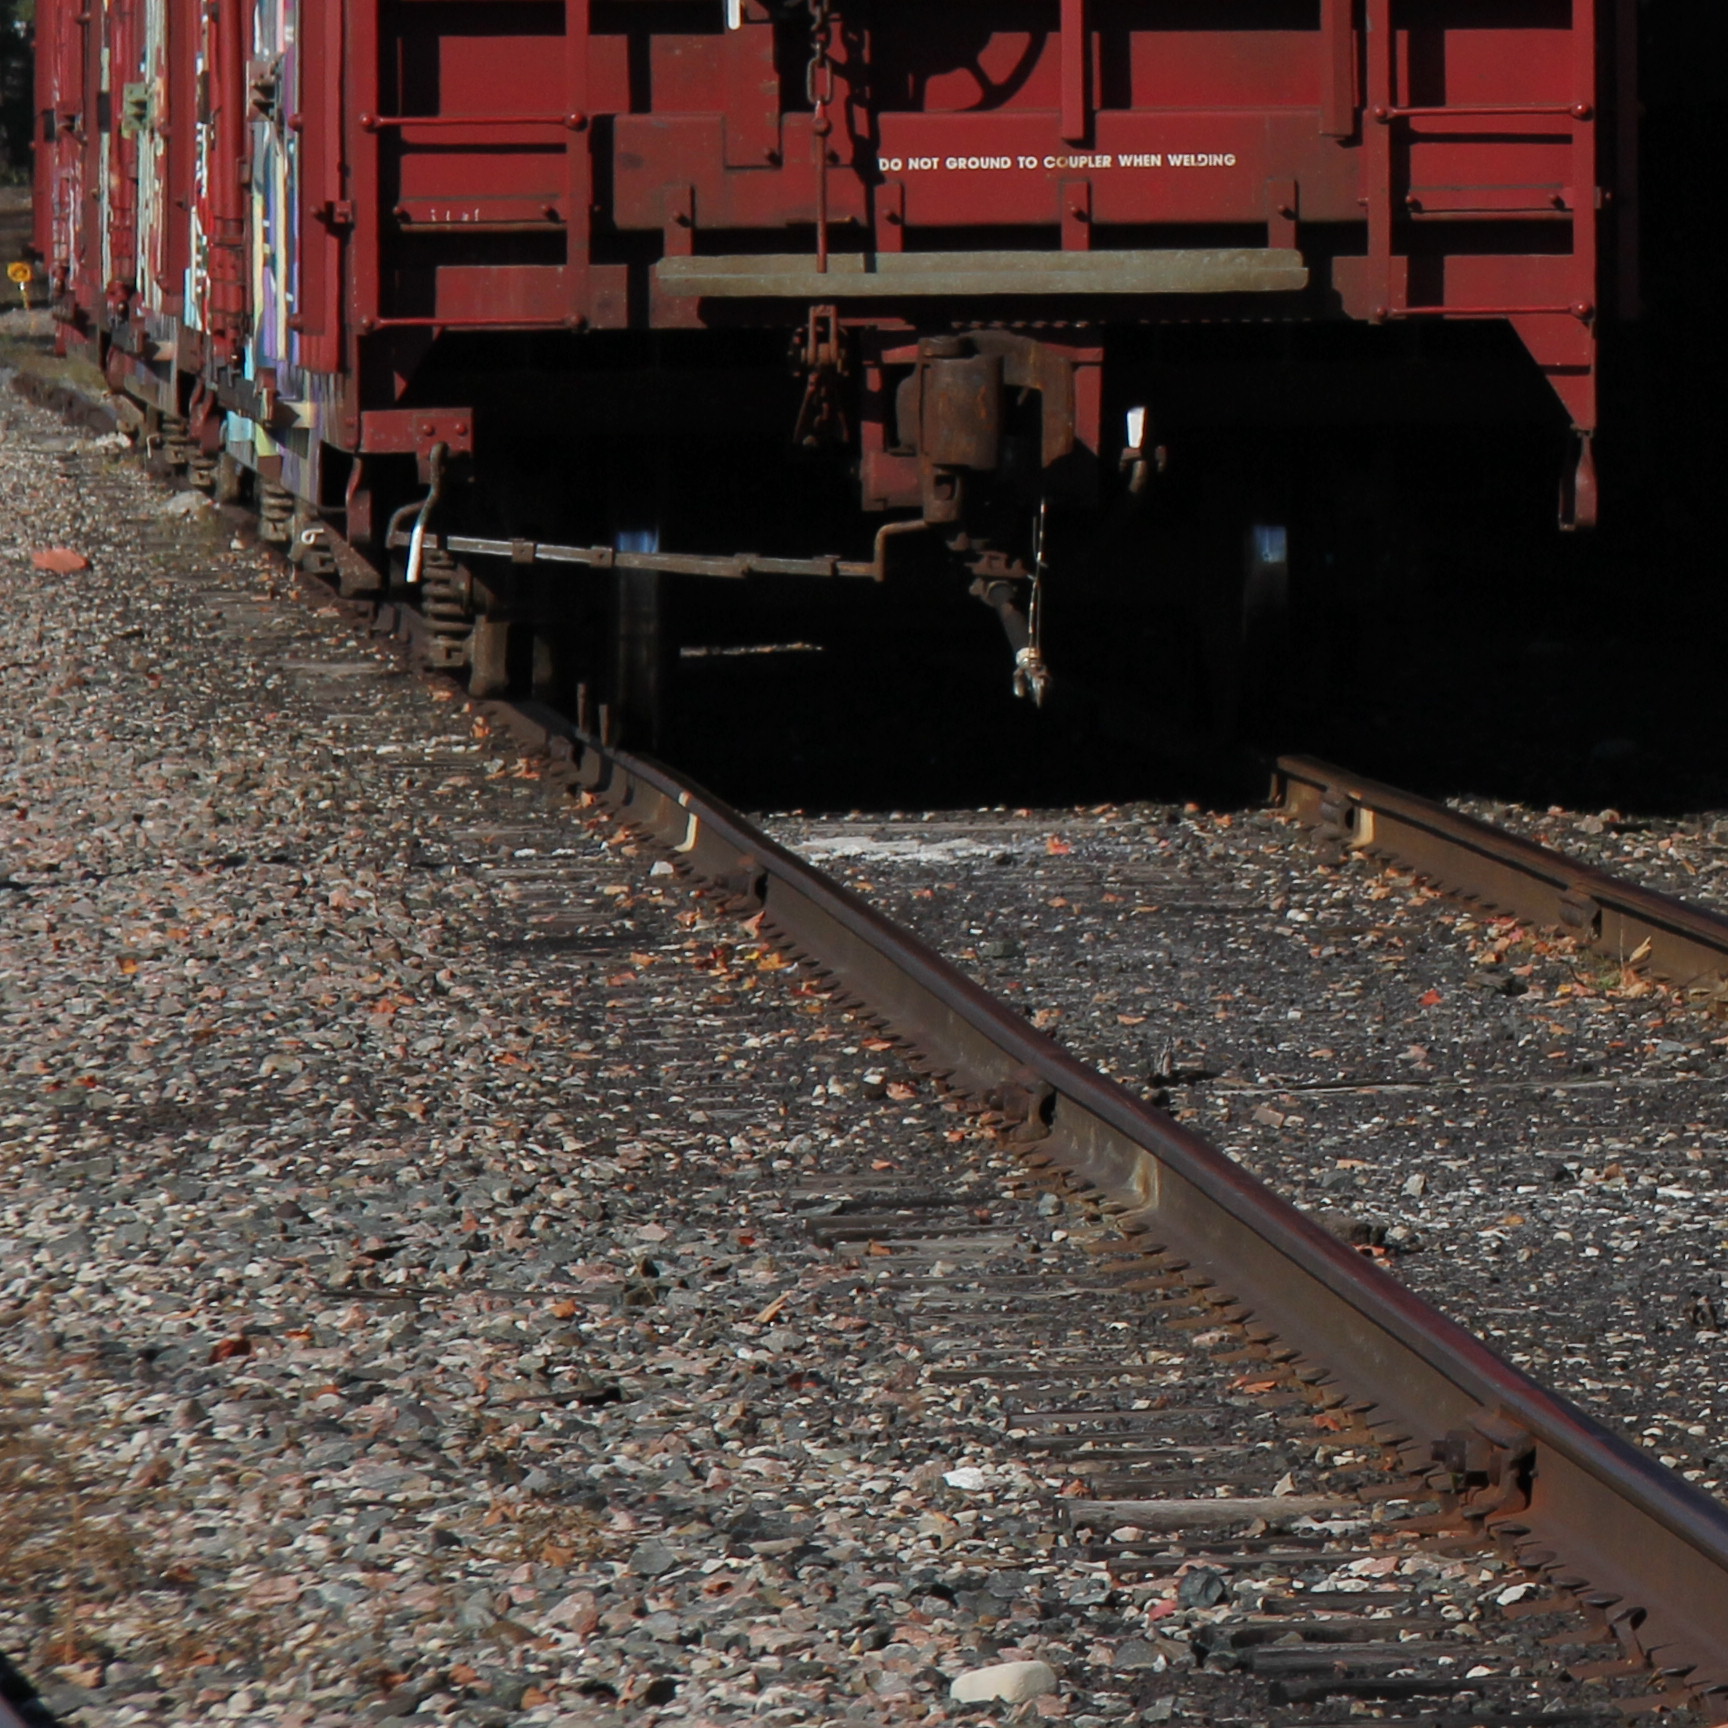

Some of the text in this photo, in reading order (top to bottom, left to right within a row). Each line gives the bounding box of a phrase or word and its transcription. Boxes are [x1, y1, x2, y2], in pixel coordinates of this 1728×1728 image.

[878, 152, 1237, 172] DO NOT GROUND TO COUPLER WHEN WELDING
